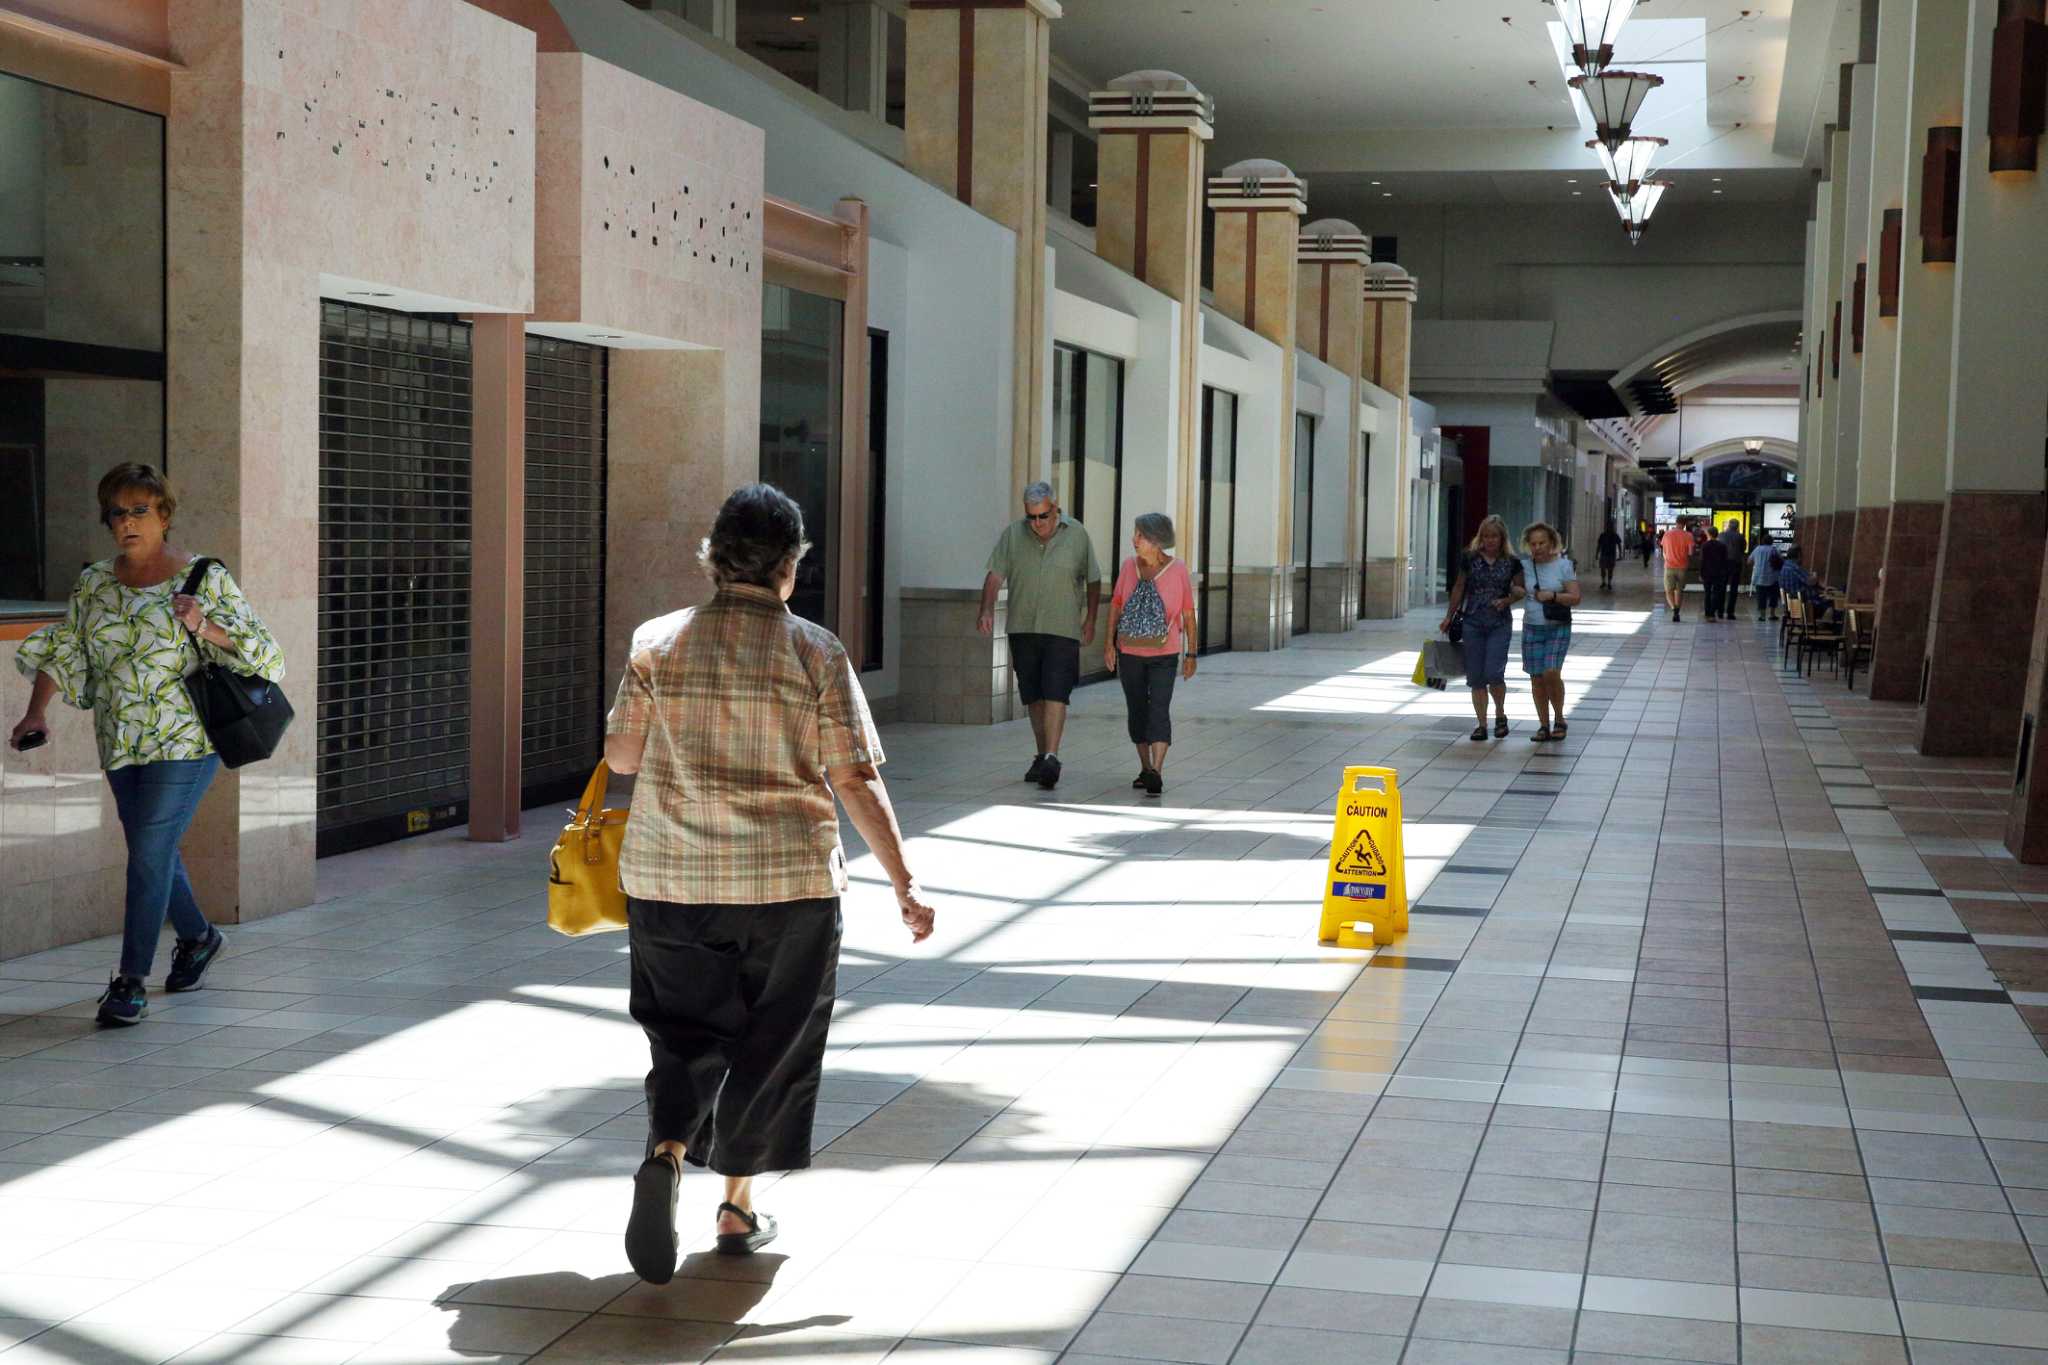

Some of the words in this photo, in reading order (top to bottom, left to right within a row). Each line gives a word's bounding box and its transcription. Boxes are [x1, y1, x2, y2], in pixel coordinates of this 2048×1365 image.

[1347, 805, 1388, 818] CAUTION
[1339, 838, 1358, 863] CAUTION
[1343, 869, 1377, 877] ATTENTION
